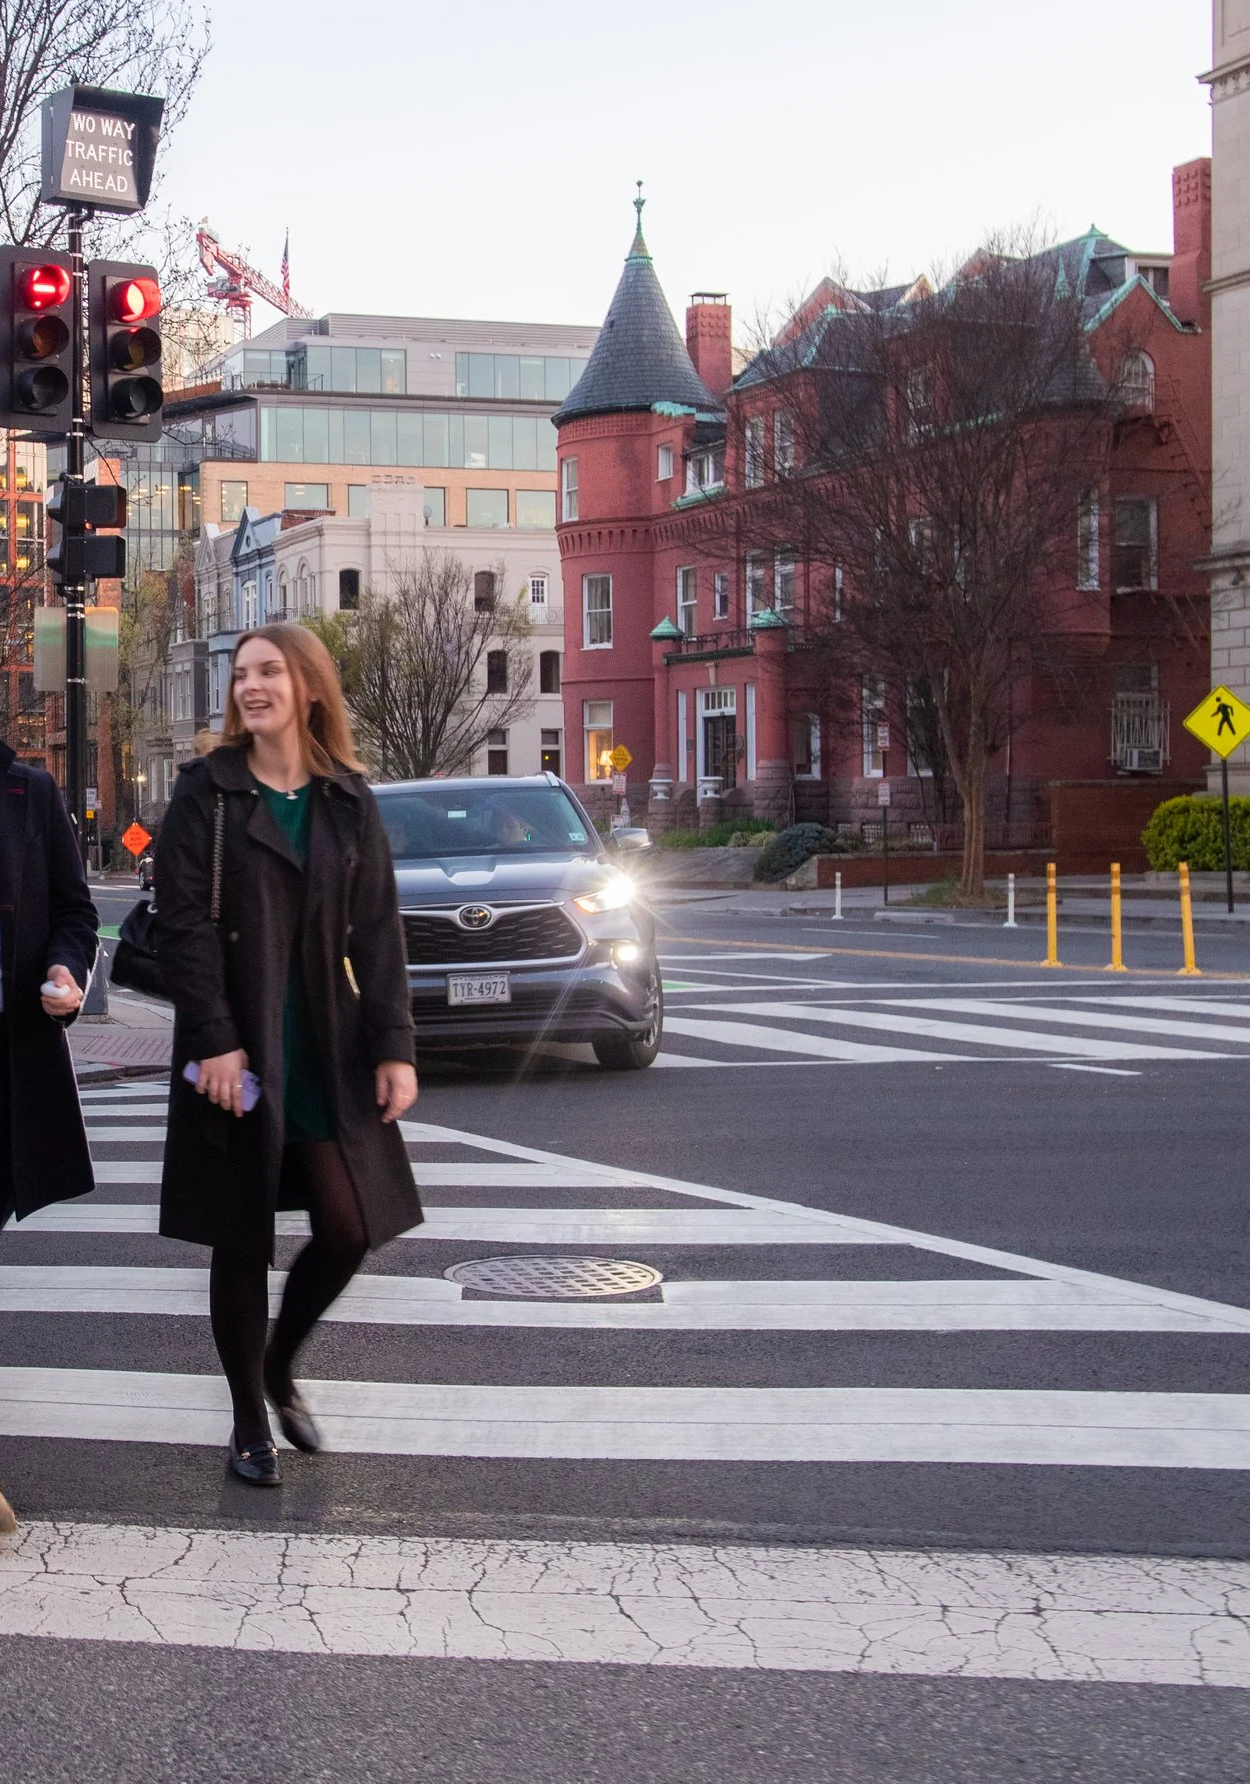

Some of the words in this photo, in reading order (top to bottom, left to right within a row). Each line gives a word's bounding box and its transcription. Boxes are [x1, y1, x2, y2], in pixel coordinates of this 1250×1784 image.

[70, 113, 96, 133] WO
[100, 118, 136, 140] WAY
[66, 139, 134, 167] TRAFFIC
[70, 169, 128, 193] AHEAD
[452, 980, 506, 997] TYR-4972
